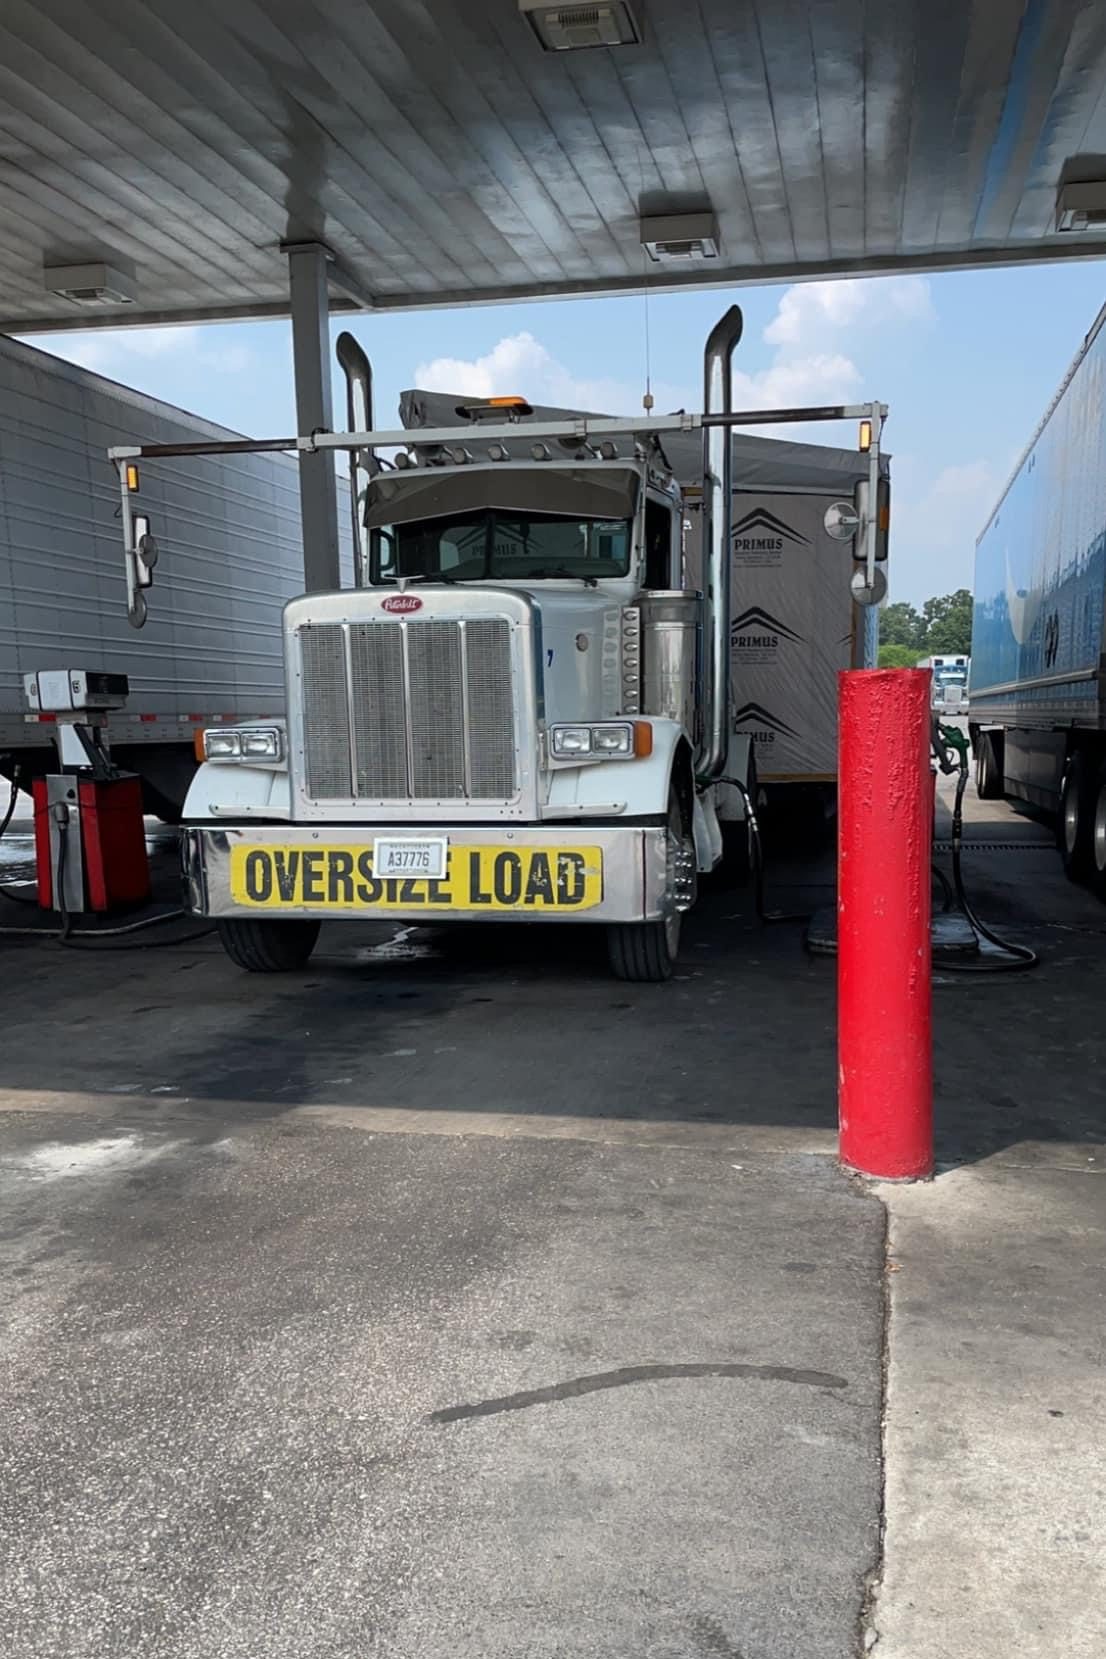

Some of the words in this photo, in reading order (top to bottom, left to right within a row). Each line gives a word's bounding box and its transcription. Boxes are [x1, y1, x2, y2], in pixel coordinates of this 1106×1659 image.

[734, 538, 783, 550] PRIMUS
[731, 636, 779, 647] PRIMUS
[387, 851, 430, 867] A37776
[470, 851, 586, 904] LOAD
